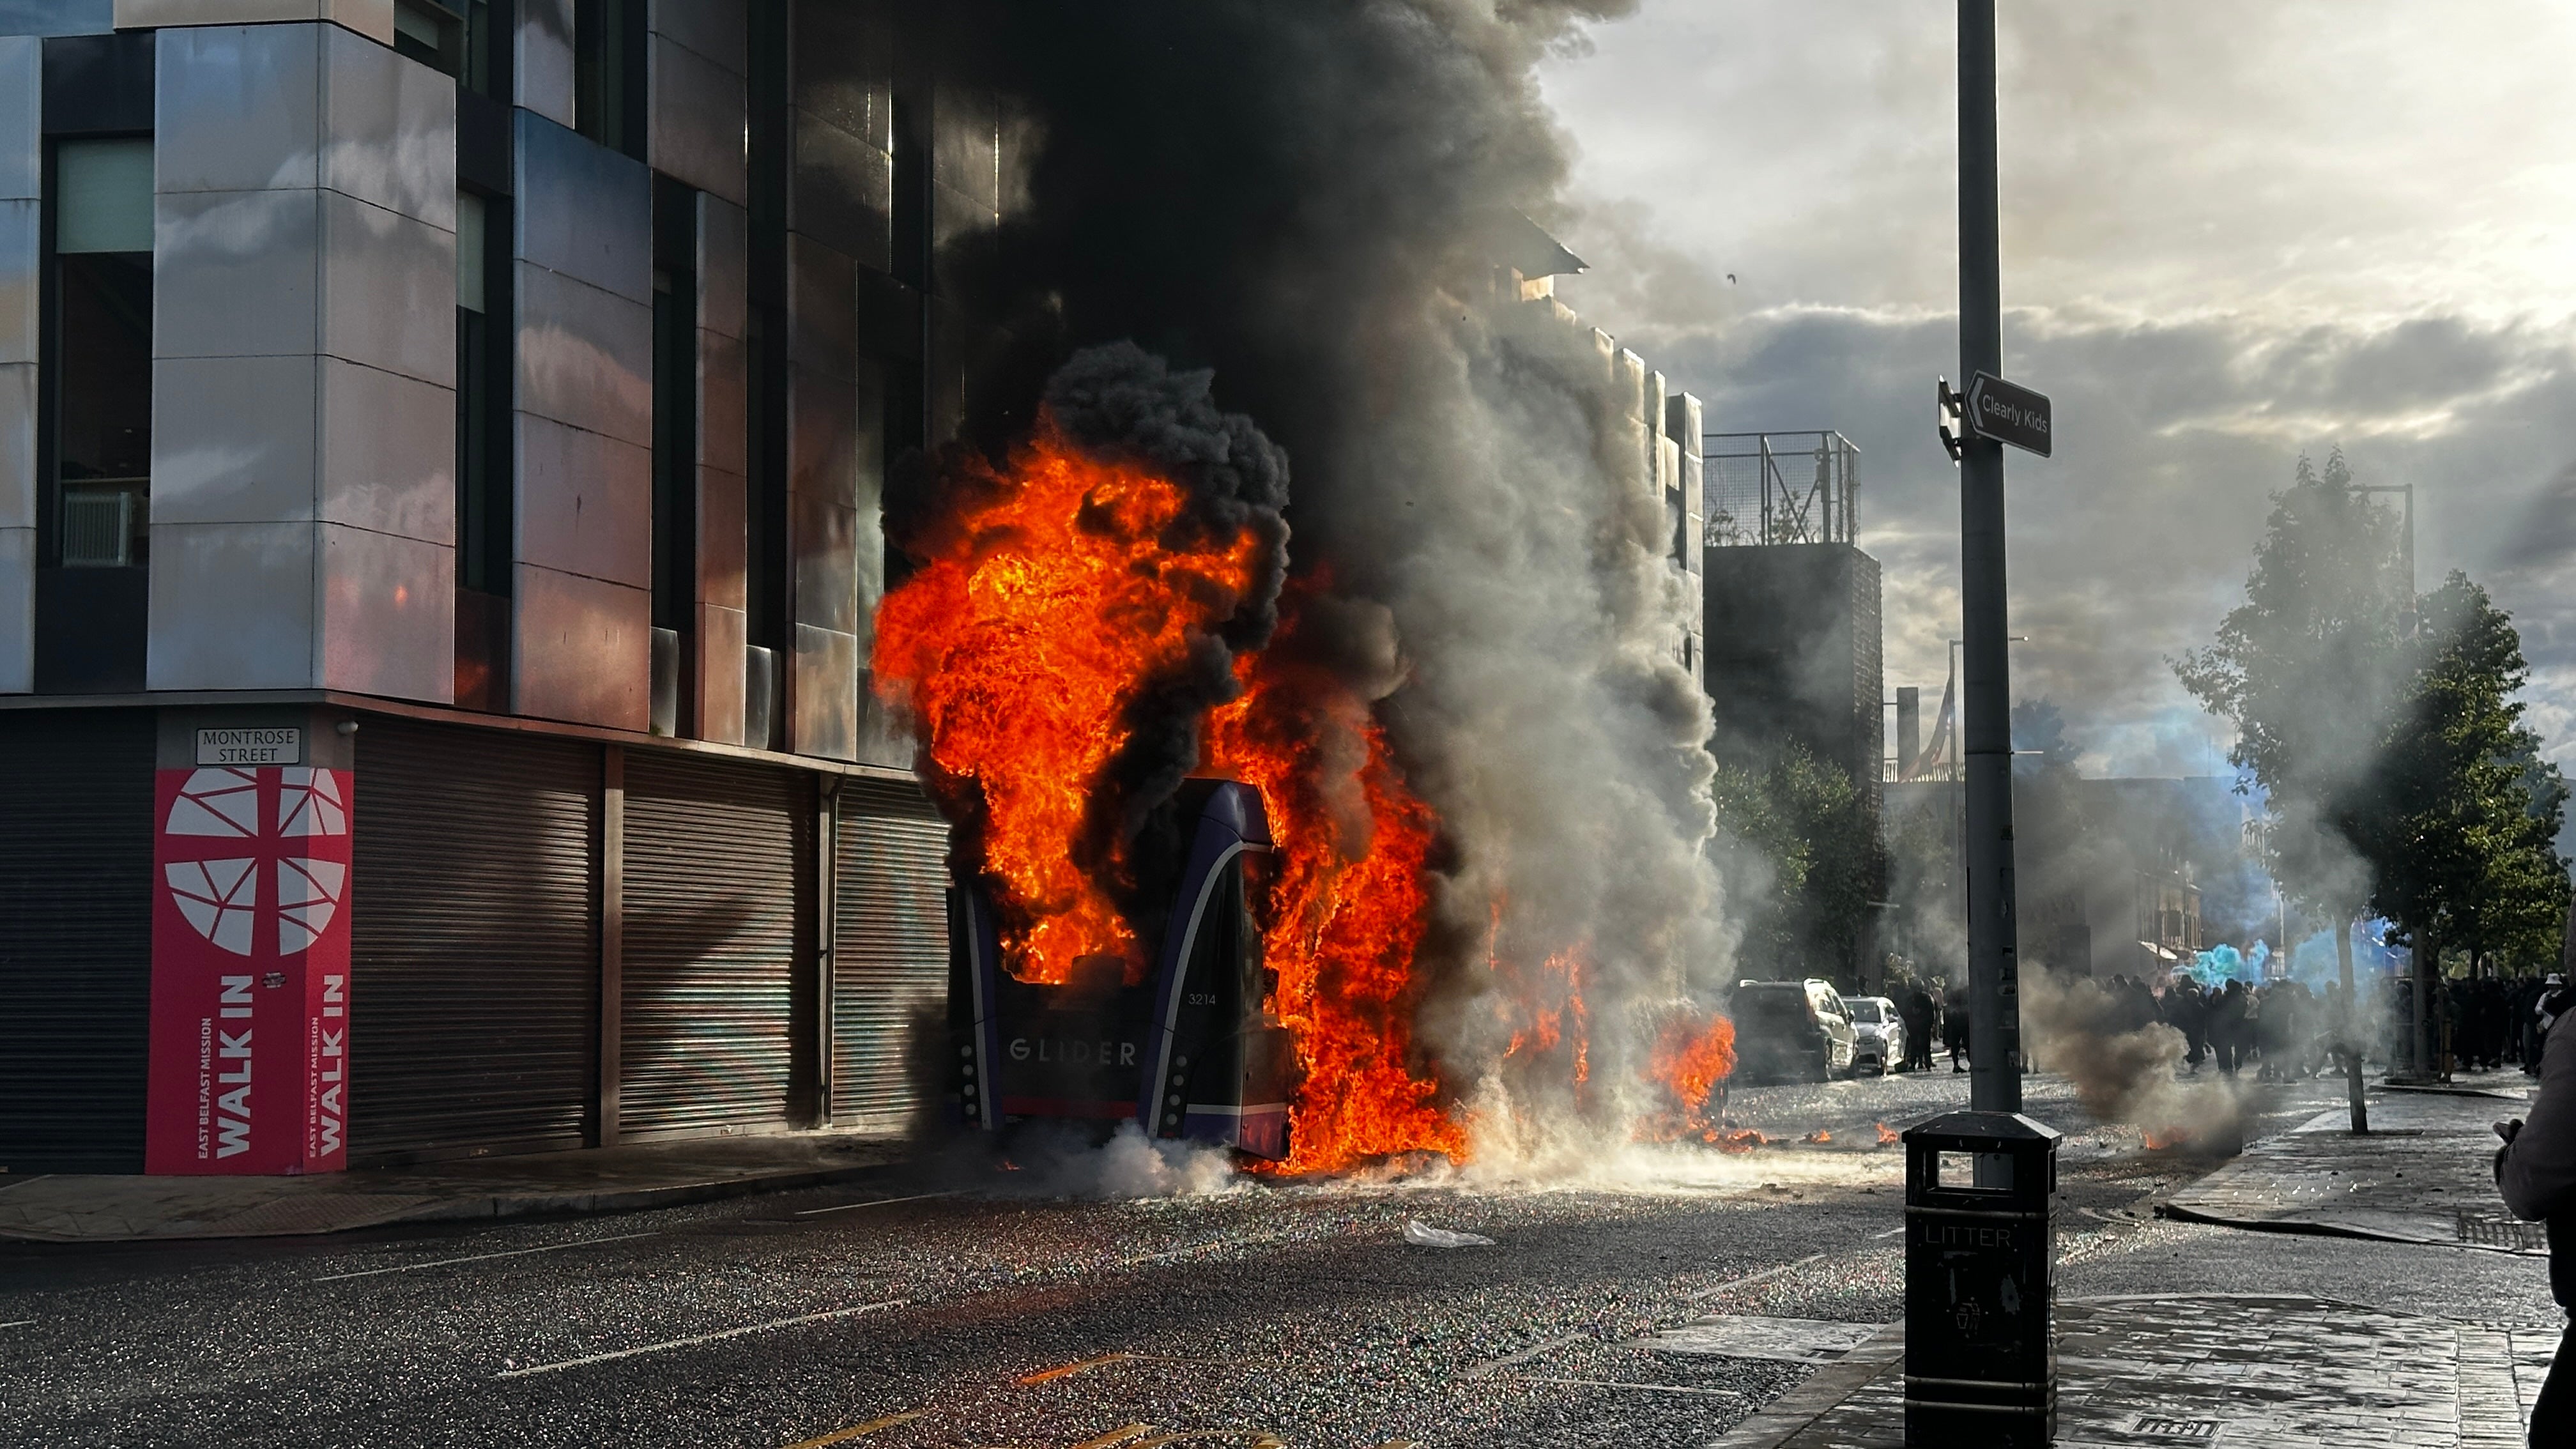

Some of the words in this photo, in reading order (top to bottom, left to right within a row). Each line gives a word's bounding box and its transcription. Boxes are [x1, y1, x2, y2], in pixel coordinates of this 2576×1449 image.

[1982, 394, 2021, 426] Clearly
[2025, 409, 2048, 433] Kids
[203, 730, 294, 745] MONTROSE
[219, 748, 278, 762] STREET
[220, 976, 253, 1018] IN
[323, 975, 344, 1017] IN
[1188, 993, 1216, 1006] 3214
[201, 1018, 211, 1070] MISSION
[1009, 1038, 1136, 1066] GLIDER
[199, 1071, 211, 1125] BELFAST
[217, 1028, 252, 1159] WALK
[321, 1027, 342, 1157] WALK
[198, 1127, 209, 1159] EAST
[1925, 1223, 2012, 1248] LITTER
